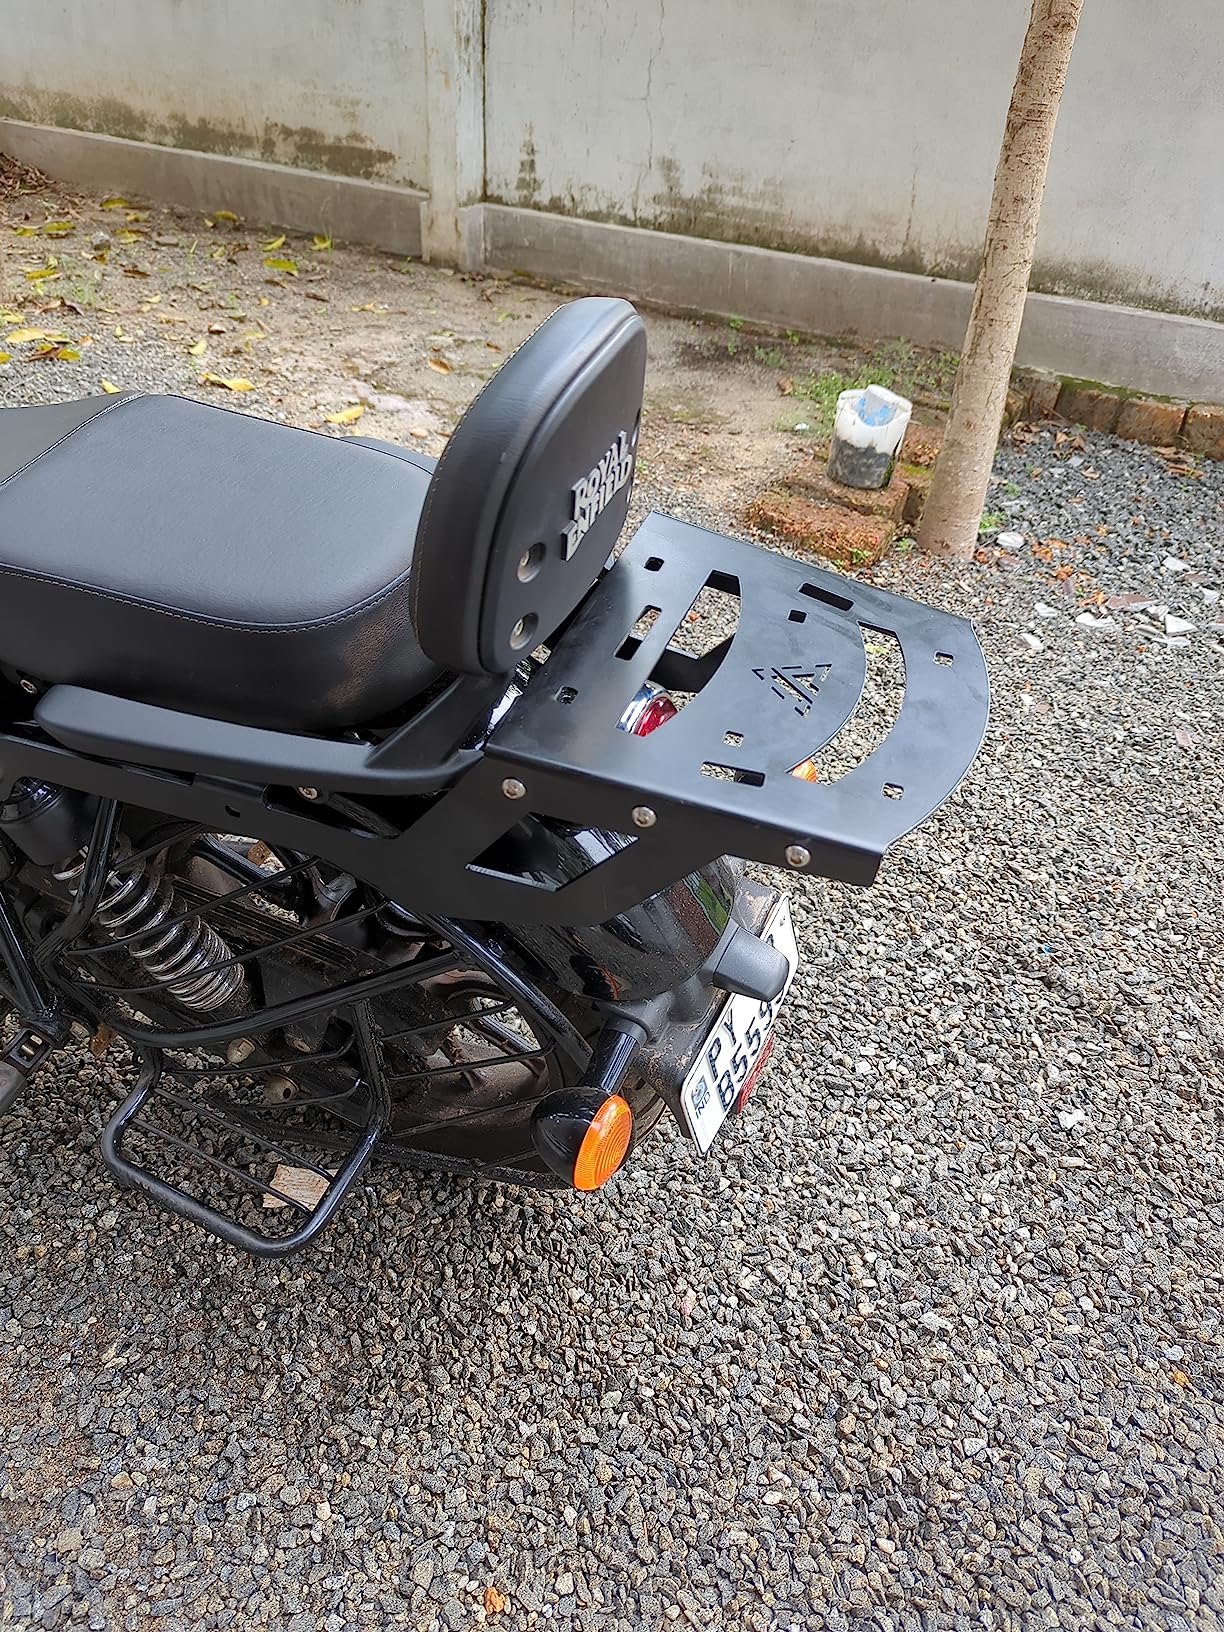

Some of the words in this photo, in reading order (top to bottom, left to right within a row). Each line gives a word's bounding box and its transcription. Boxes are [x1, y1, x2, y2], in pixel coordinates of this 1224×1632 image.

[561, 454, 633, 562] ENFIELD
[571, 430, 629, 521] ROYAL
[695, 1091, 711, 1120] IND
